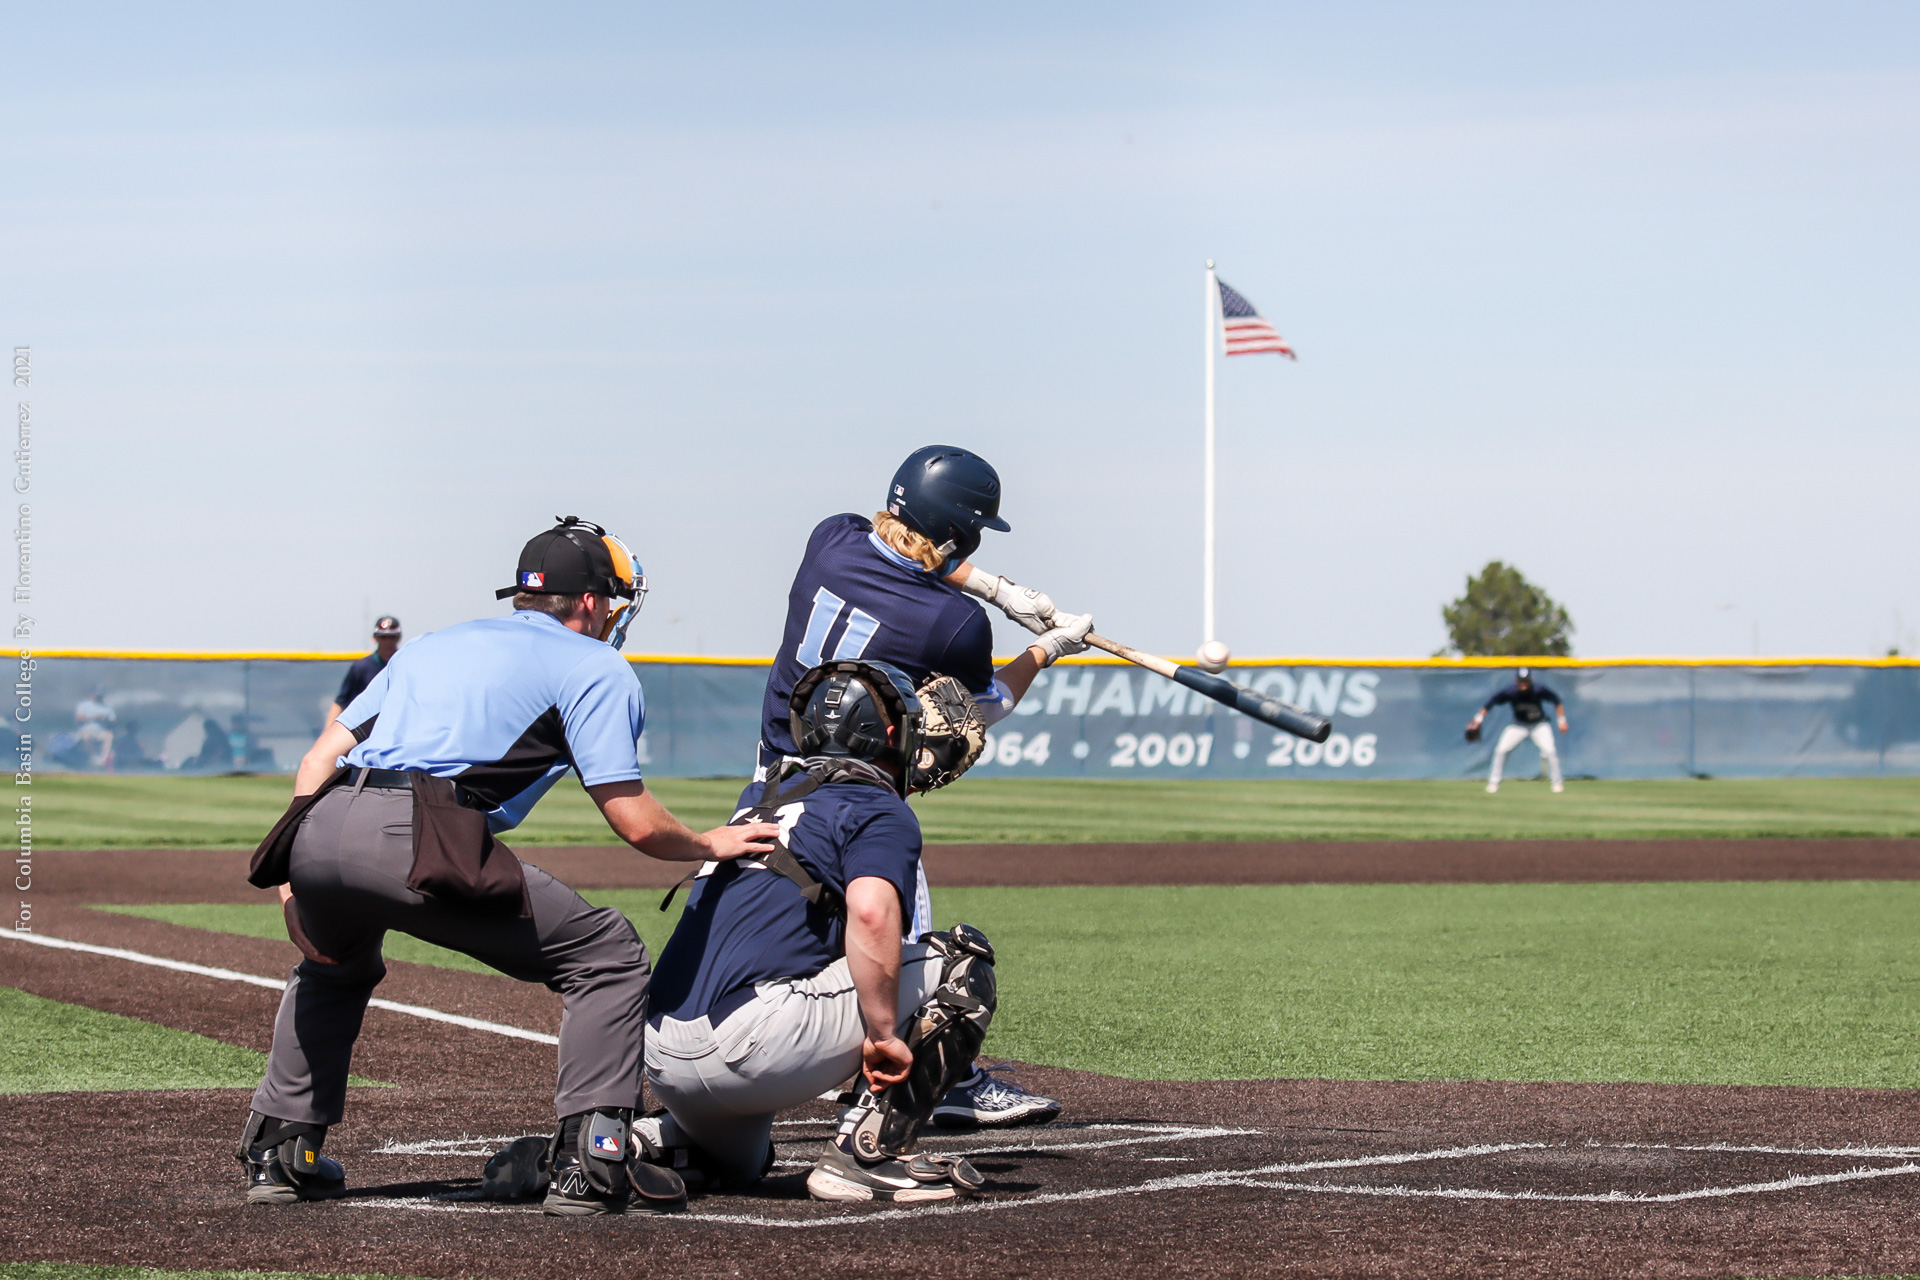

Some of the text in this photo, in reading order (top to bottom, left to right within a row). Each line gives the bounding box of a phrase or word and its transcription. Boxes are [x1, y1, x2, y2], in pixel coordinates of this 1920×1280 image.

[796, 586, 881, 669] 11
[1110, 732, 1214, 767] 2001
[1266, 732, 1378, 767] 2006
